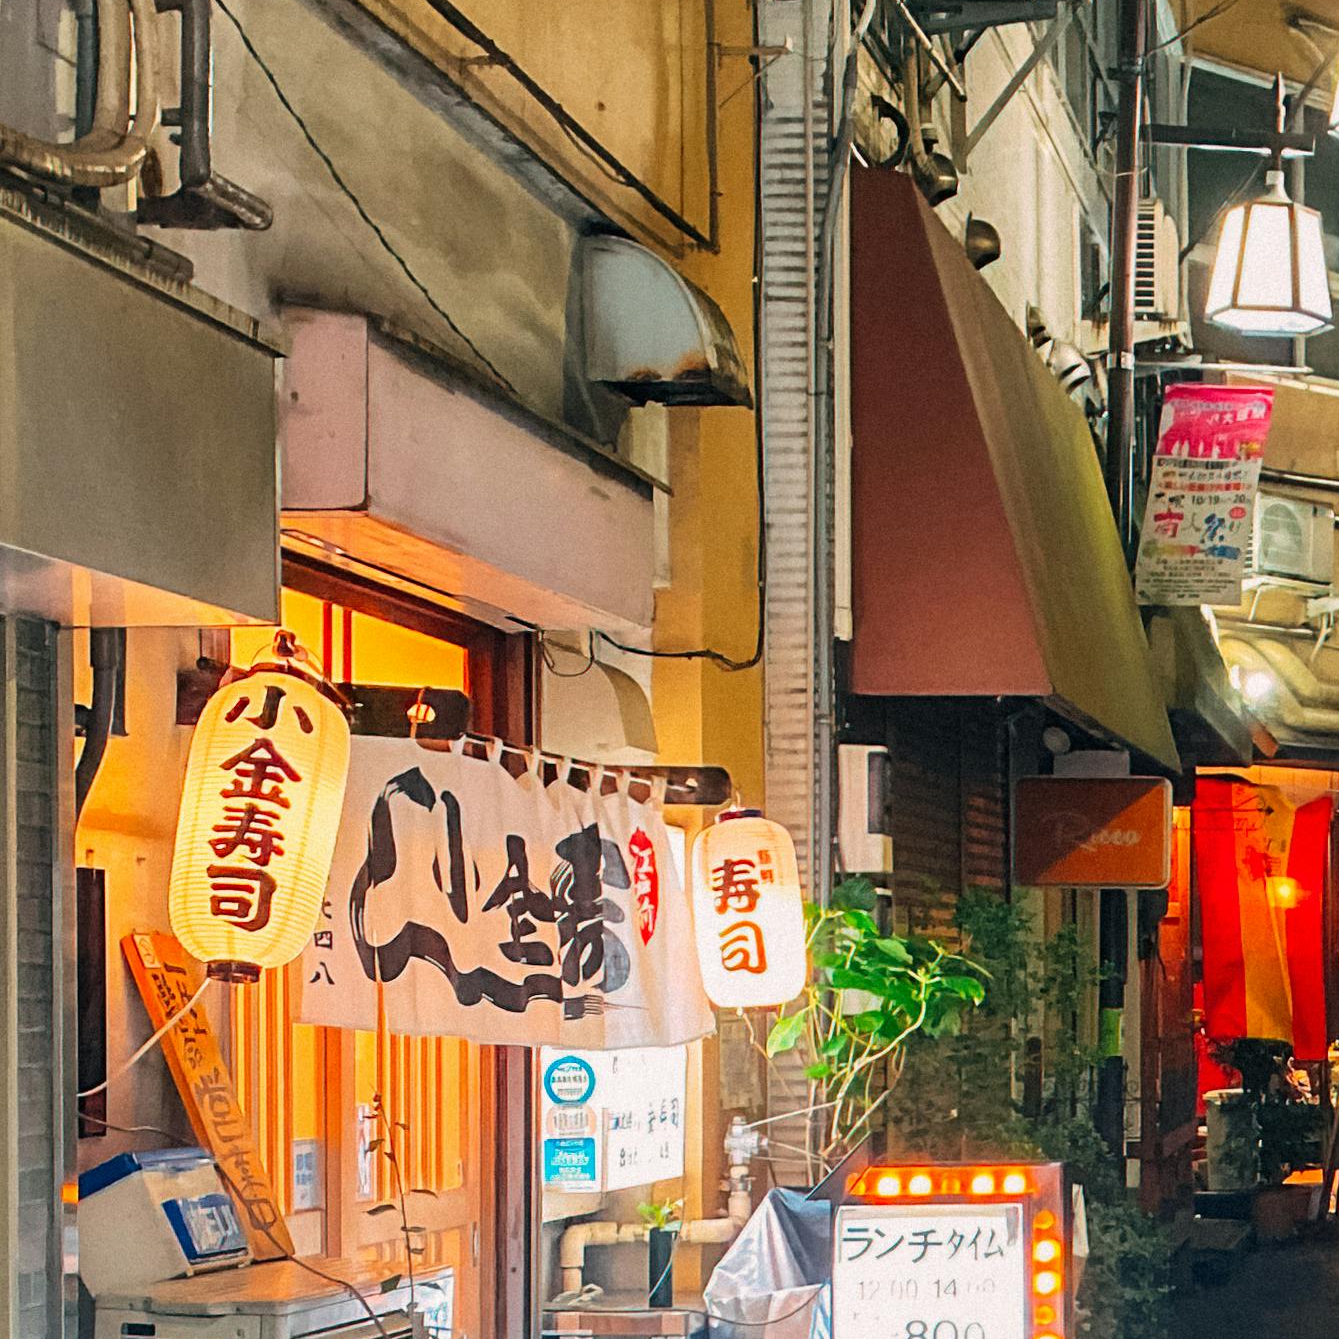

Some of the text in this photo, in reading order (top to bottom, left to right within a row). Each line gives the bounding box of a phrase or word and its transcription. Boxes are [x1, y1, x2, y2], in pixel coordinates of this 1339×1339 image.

[207, 685, 314, 932] 小金寿司
[712, 859, 767, 974] 寿司
[842, 1226, 1004, 1263] ランチタイム
